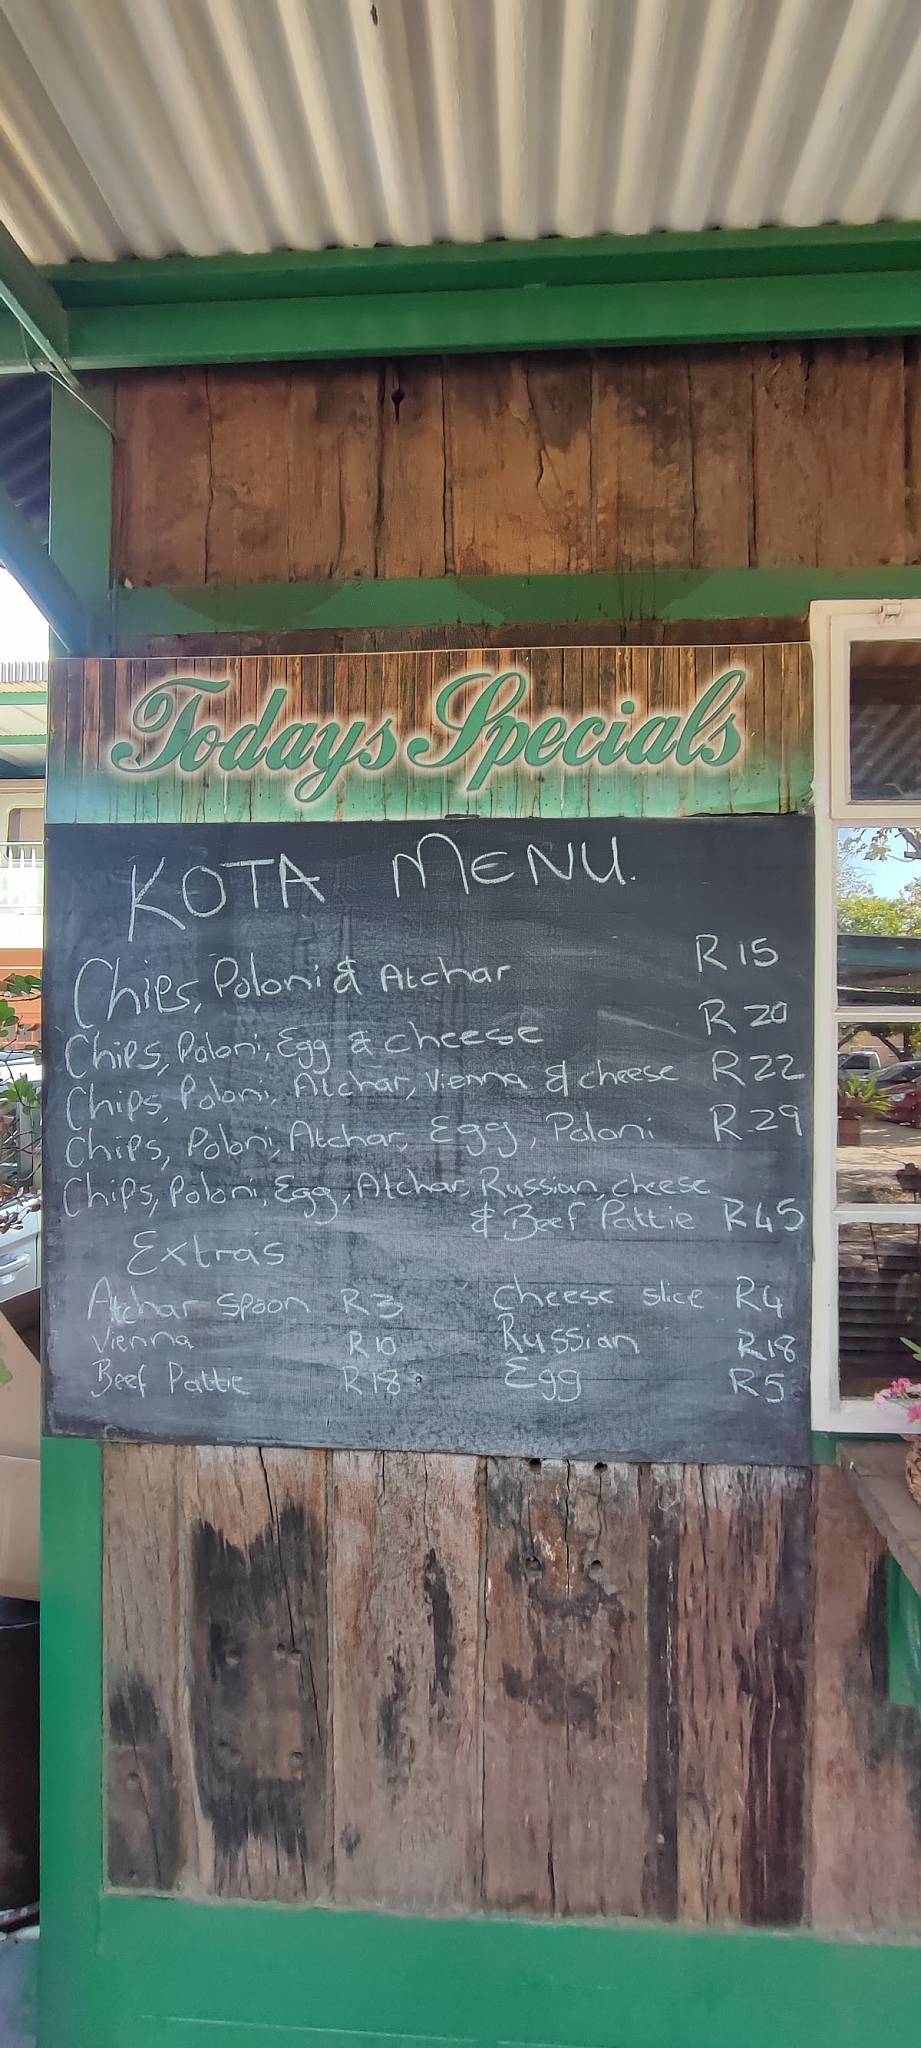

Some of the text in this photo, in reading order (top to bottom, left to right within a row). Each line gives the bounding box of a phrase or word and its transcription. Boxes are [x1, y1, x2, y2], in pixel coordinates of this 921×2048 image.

[110, 671, 745, 802] Todays Specials
[128, 853, 325, 942] KOTA
[214, 952, 321, 998] Poloni
[380, 956, 511, 992] Atchar
[277, 1027, 331, 1074] Egg
[385, 1021, 544, 1052] cheese
[579, 1059, 680, 1089] cheese
[545, 1111, 654, 1142] Poloni
[611, 1172, 711, 1198] cheese
[503, 1203, 586, 1242] Beef
[601, 1199, 696, 1232] Pattie
[87, 1275, 203, 1325] Atchar
[642, 1279, 705, 1309] slice
[497, 1312, 641, 1355] Russian
[90, 1358, 251, 1399] Beef Pattie
[504, 1357, 583, 1402] Egg
